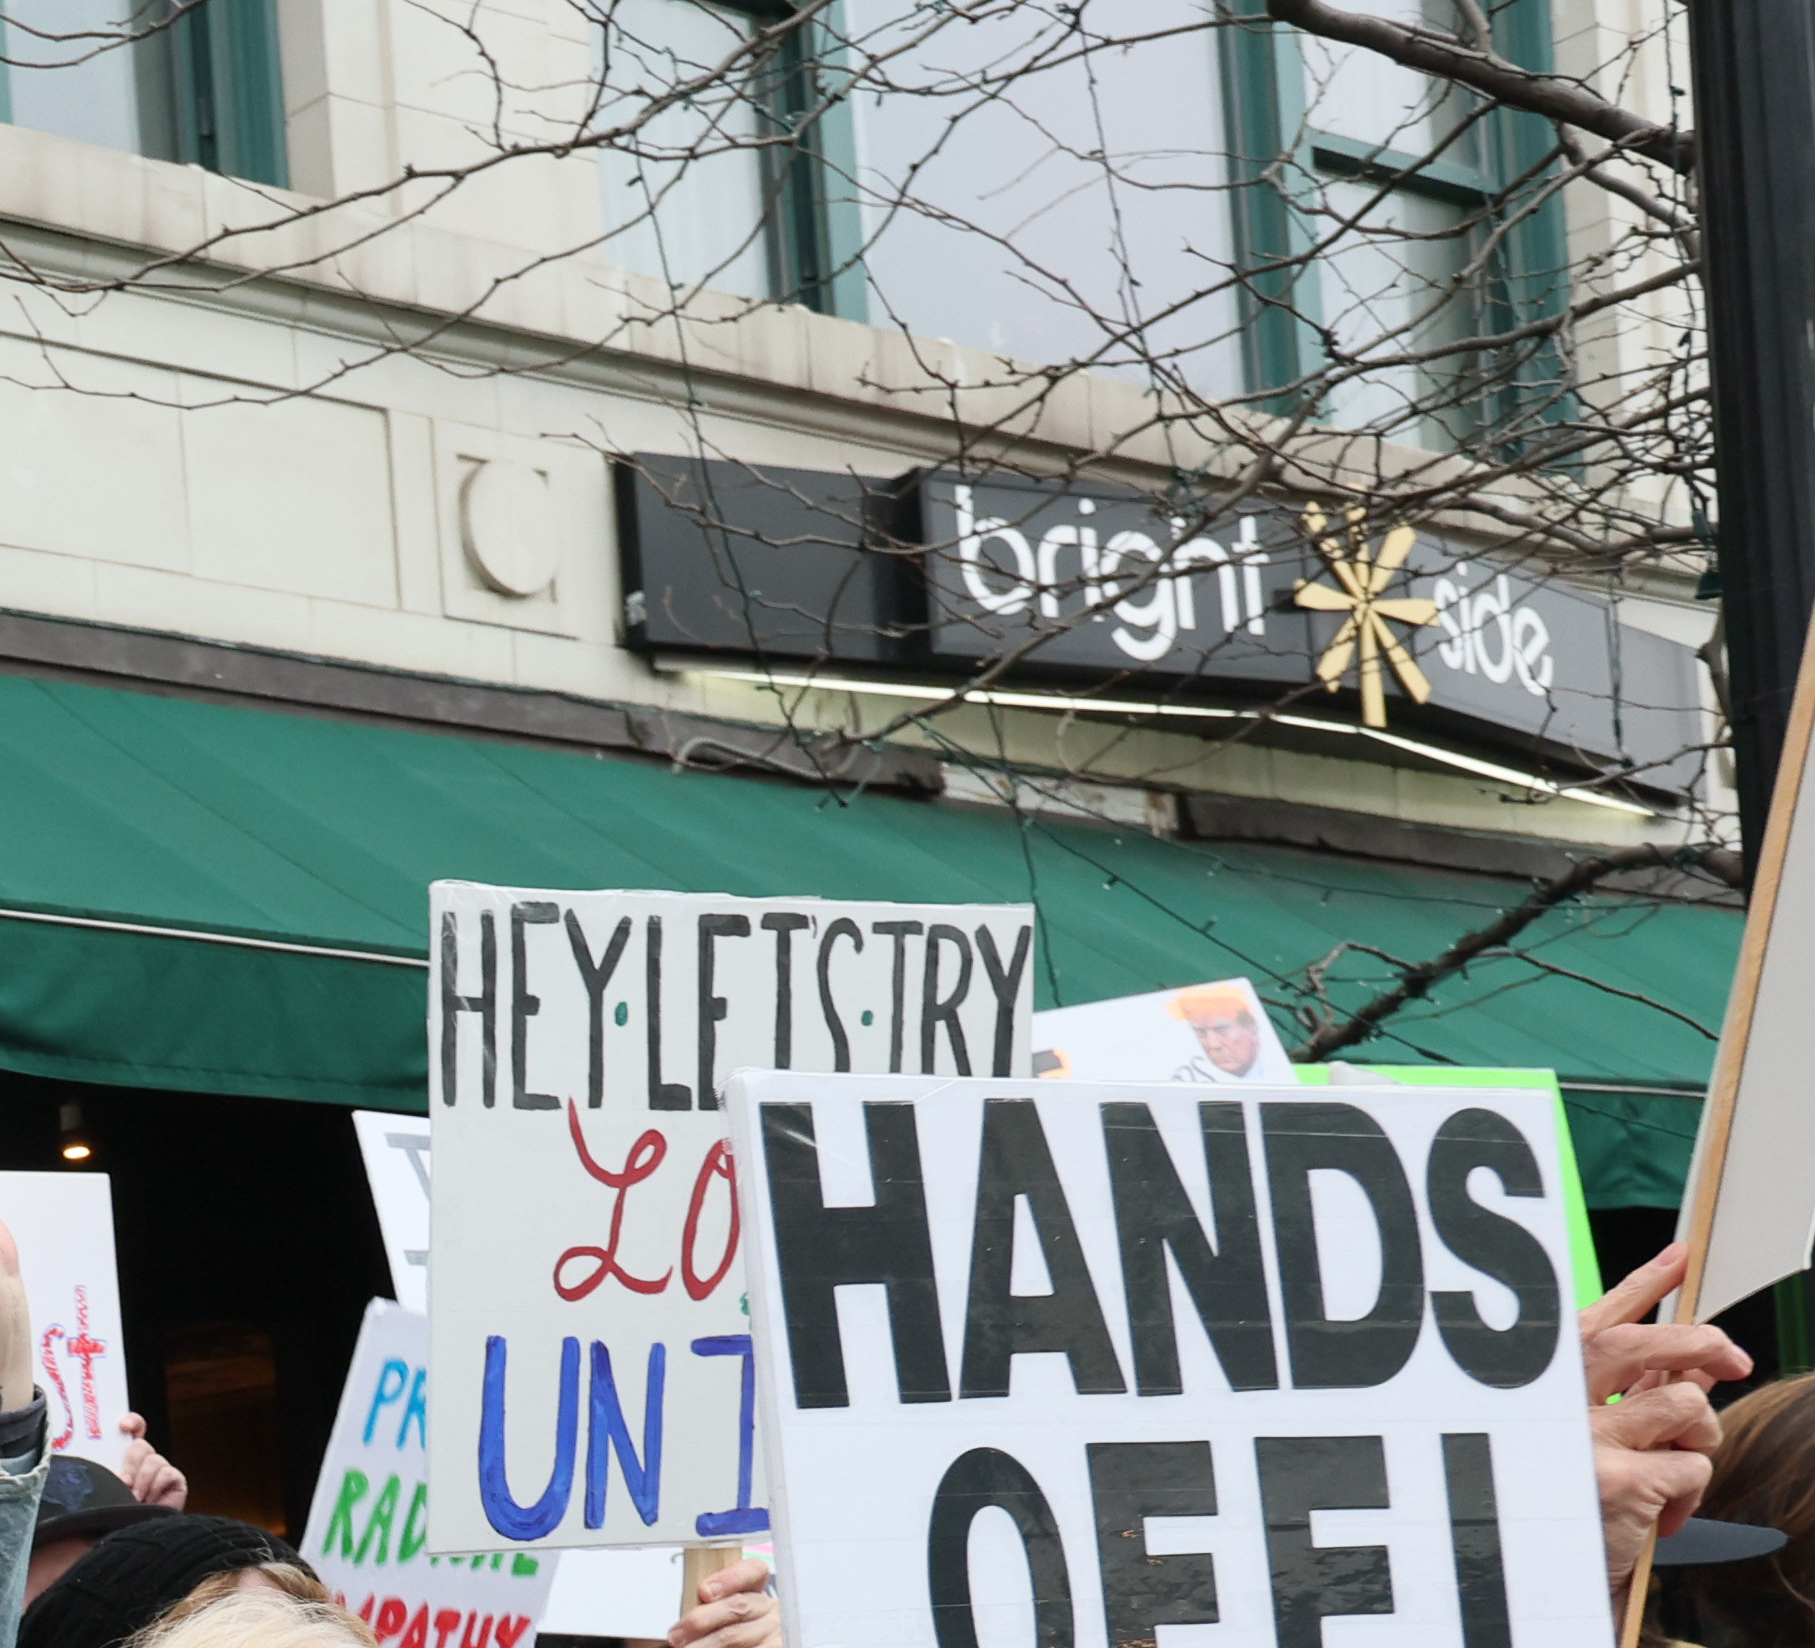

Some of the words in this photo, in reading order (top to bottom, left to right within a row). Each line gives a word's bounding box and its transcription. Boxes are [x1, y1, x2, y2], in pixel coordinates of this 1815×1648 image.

[954, 485, 1269, 662] bright
[1434, 562, 1554, 697] side
[760, 1098, 1562, 1410] HANDS
